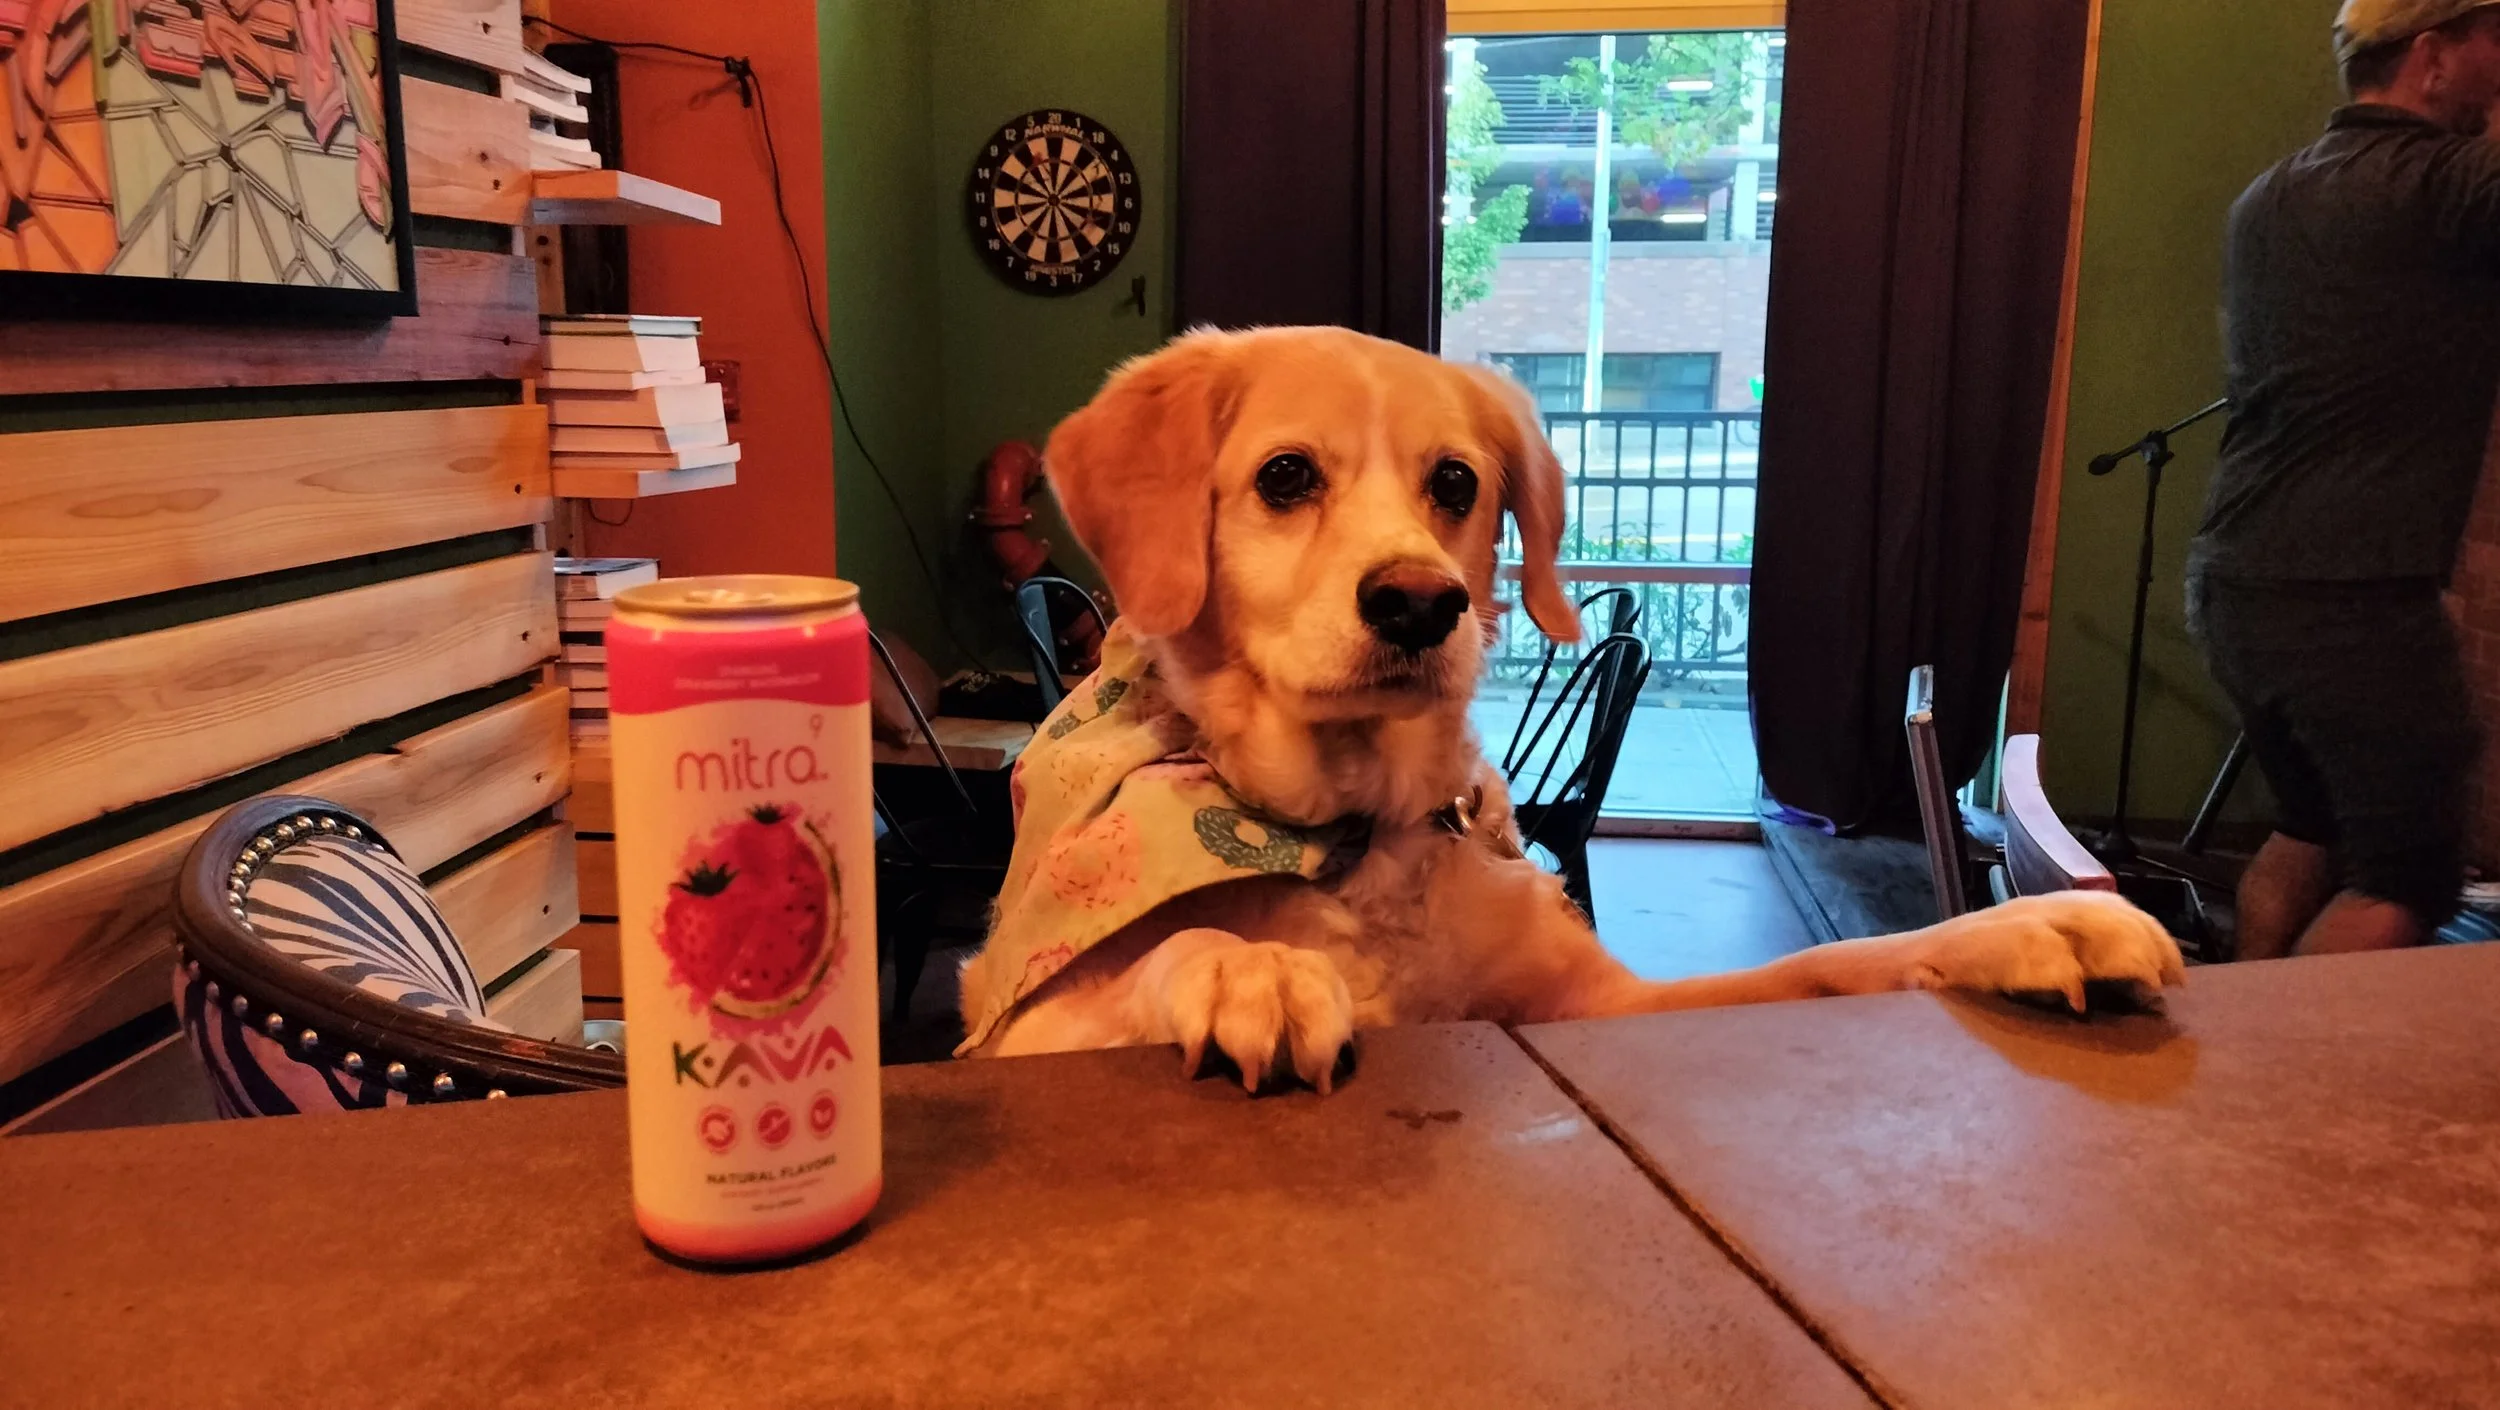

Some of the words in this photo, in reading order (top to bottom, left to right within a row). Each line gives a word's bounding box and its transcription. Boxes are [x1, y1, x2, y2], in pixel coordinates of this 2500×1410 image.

[1048, 112, 1062, 125] 20
[1075, 117, 1081, 128] 1
[1005, 128, 1017, 141] 12
[1092, 131, 1105, 144] 18
[990, 145, 999, 157] 9
[1110, 149, 1119, 161] 4
[977, 167, 990, 179] 14
[1119, 172, 1132, 185] 13
[975, 191, 986, 204] 11
[1124, 197, 1133, 209] 6
[979, 215, 988, 228] 8
[1118, 221, 1131, 234] 10
[987, 238, 1000, 251] 16
[1107, 243, 1120, 255] 15
[1006, 255, 1015, 268] 7
[1093, 260, 1101, 271] 2
[1049, 276, 1058, 287] 3
[1071, 272, 1083, 284] 17
[675, 738, 823, 792] mitra
[671, 1024, 854, 1089] KAVA
[706, 1170, 776, 1185] NATURAL
